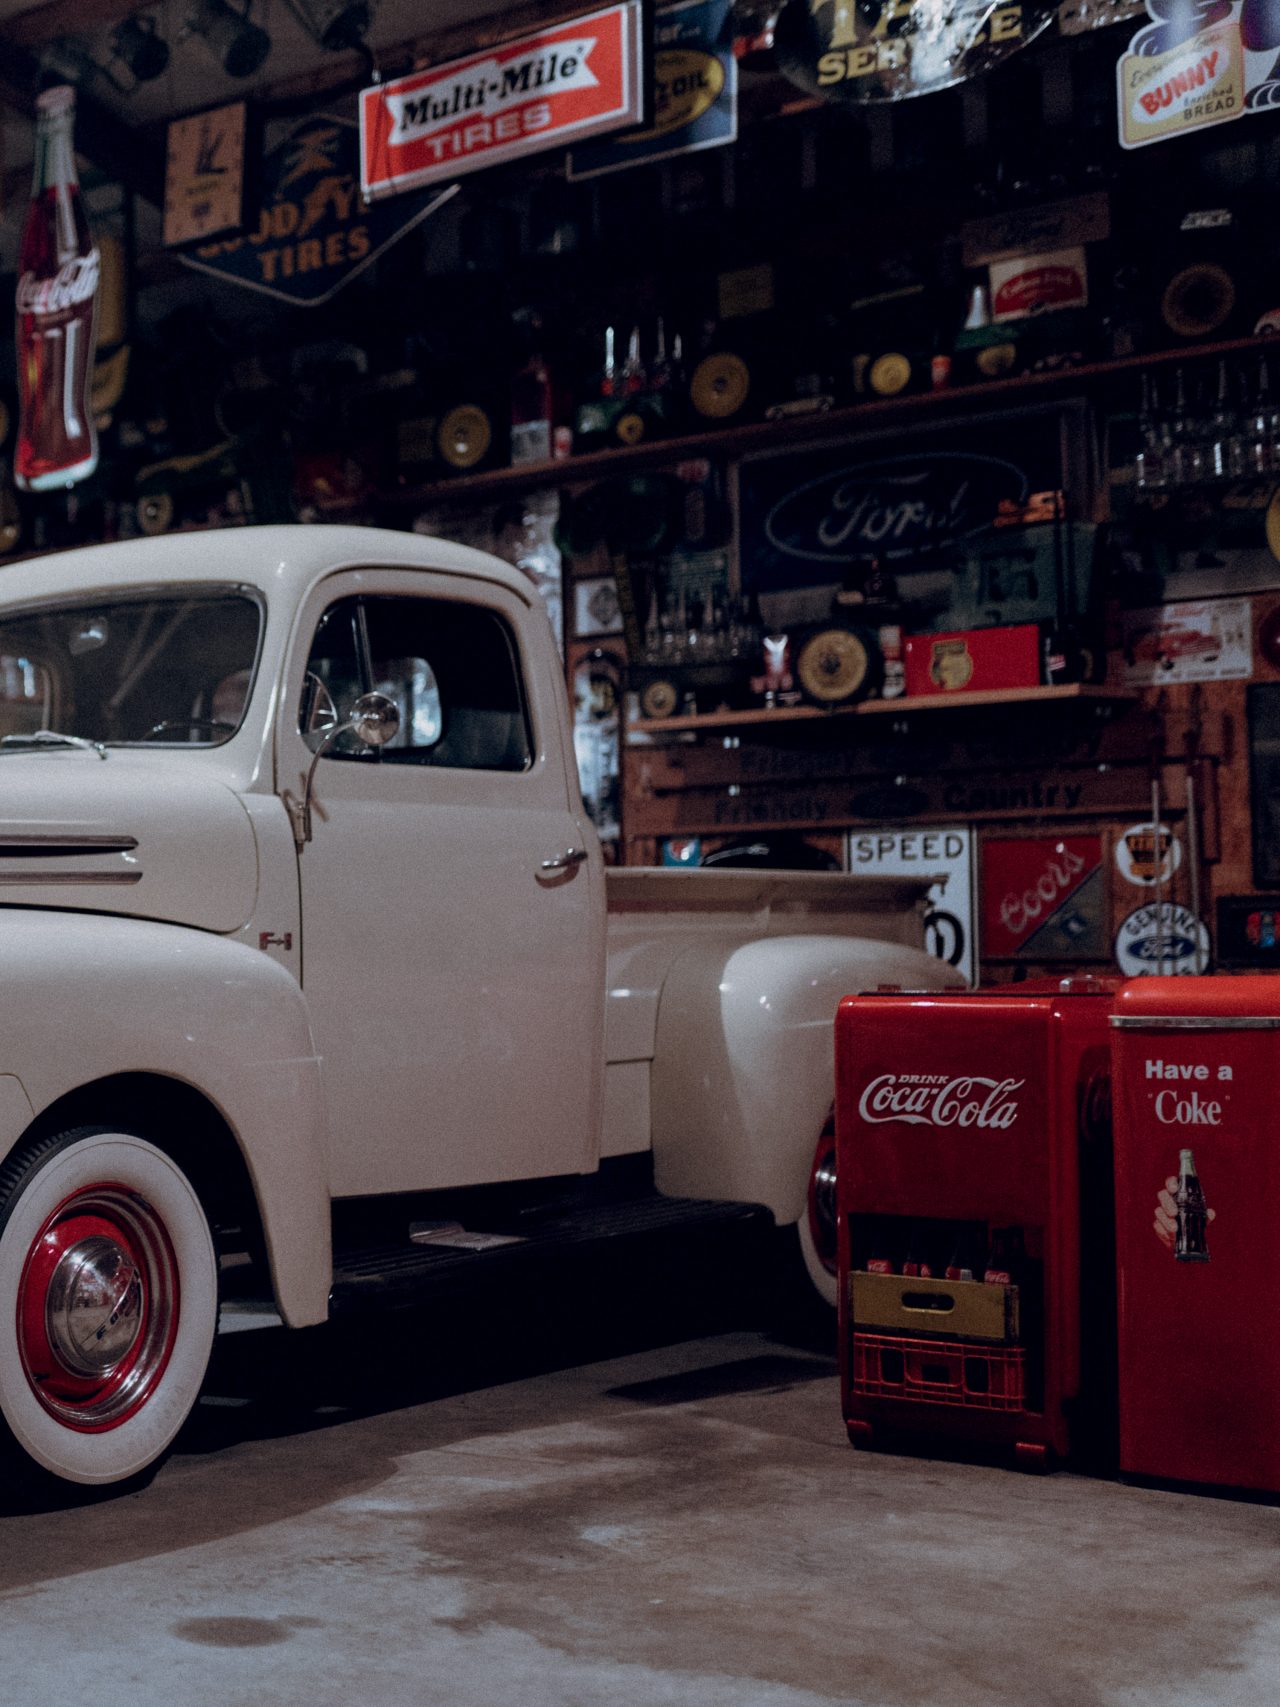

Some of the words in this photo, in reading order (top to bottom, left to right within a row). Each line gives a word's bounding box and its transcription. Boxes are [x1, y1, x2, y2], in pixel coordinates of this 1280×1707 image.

[816, 5, 1022, 87] SERE
[400, 53, 578, 131] Multi-Mile
[1139, 50, 1219, 116] BUNNY
[1183, 96, 1236, 121] BREAD
[425, 102, 553, 160] TIRES
[256, 224, 371, 284] TIRES
[945, 784, 1084, 812] Country
[856, 834, 964, 863] SPEED
[1000, 849, 1085, 934] Coors
[898, 1074, 950, 1084] DRINK
[1145, 1060, 1210, 1081] Have
[1217, 1065, 1233, 1081] a
[858, 1074, 1026, 1130] Coca-Cola
